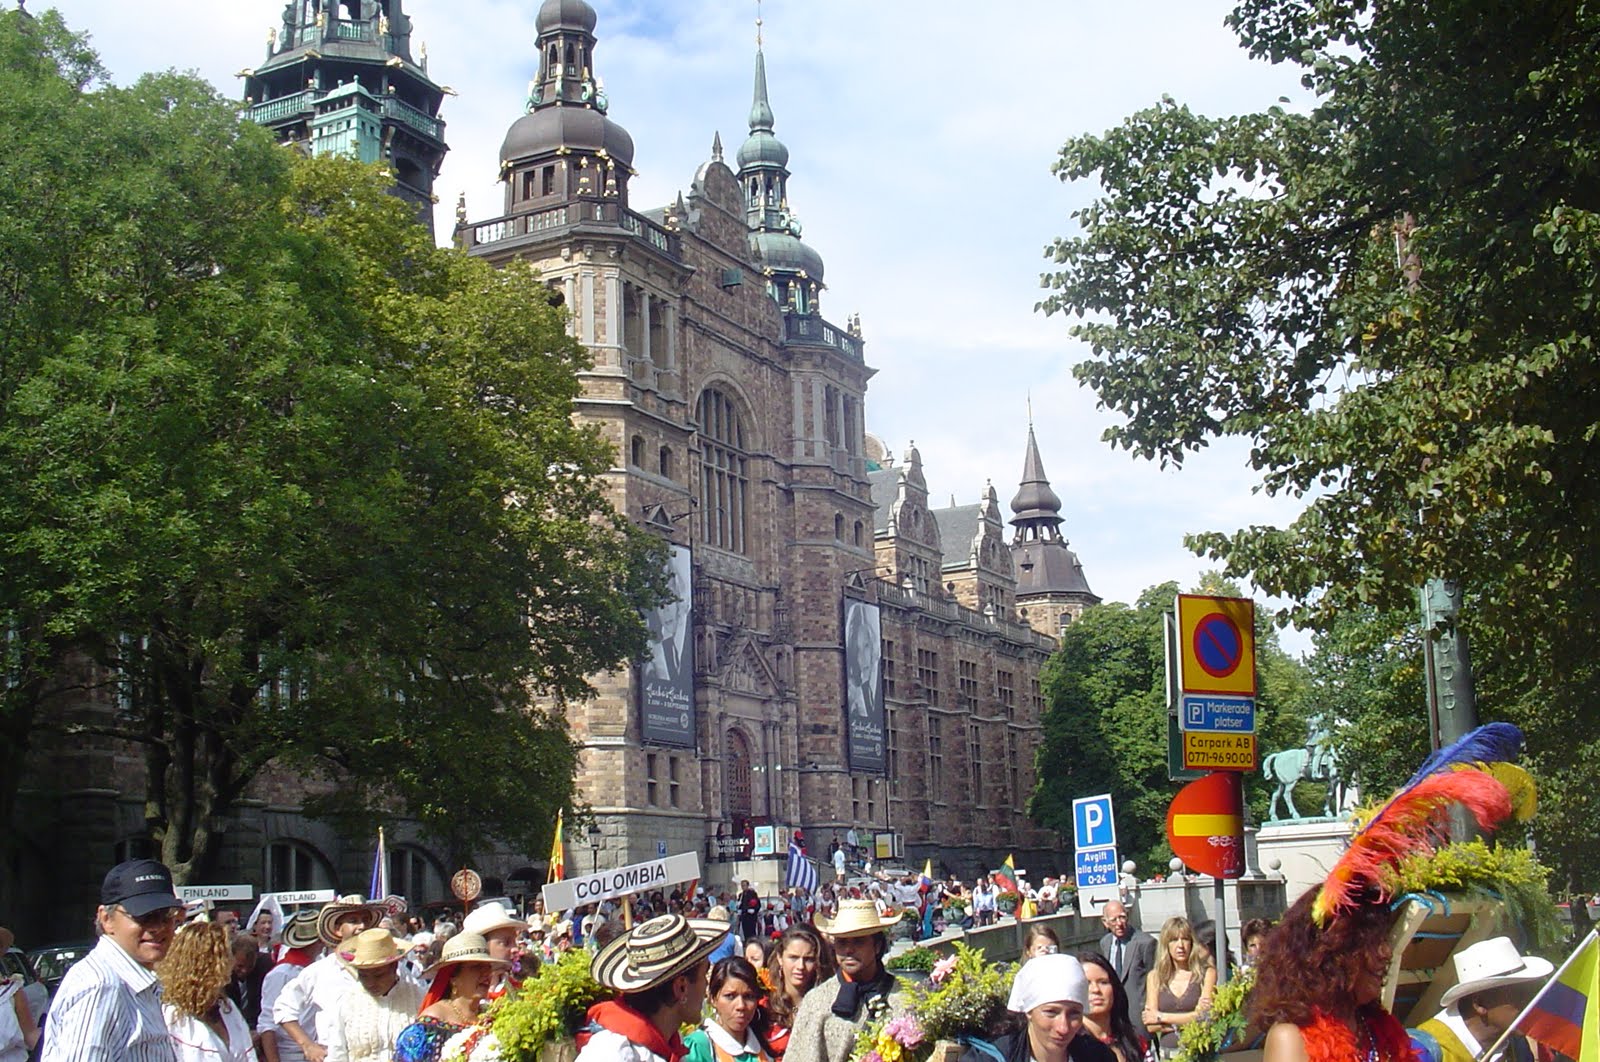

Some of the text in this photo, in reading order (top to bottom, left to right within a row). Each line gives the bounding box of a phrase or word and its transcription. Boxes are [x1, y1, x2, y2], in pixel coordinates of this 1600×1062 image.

[1192, 706, 1200, 720] P
[1207, 702, 1250, 714] Markerade
[1214, 716, 1243, 728] platser
[1190, 736, 1250, 750] Carpark AB
[1085, 803, 1103, 844] P
[1084, 851, 1107, 862] Avgift
[1077, 863, 1115, 874] alla dagar
[576, 864, 666, 899] COLOMBIA
[1088, 874, 1107, 885] 0-24
[183, 888, 229, 898] FINLAND
